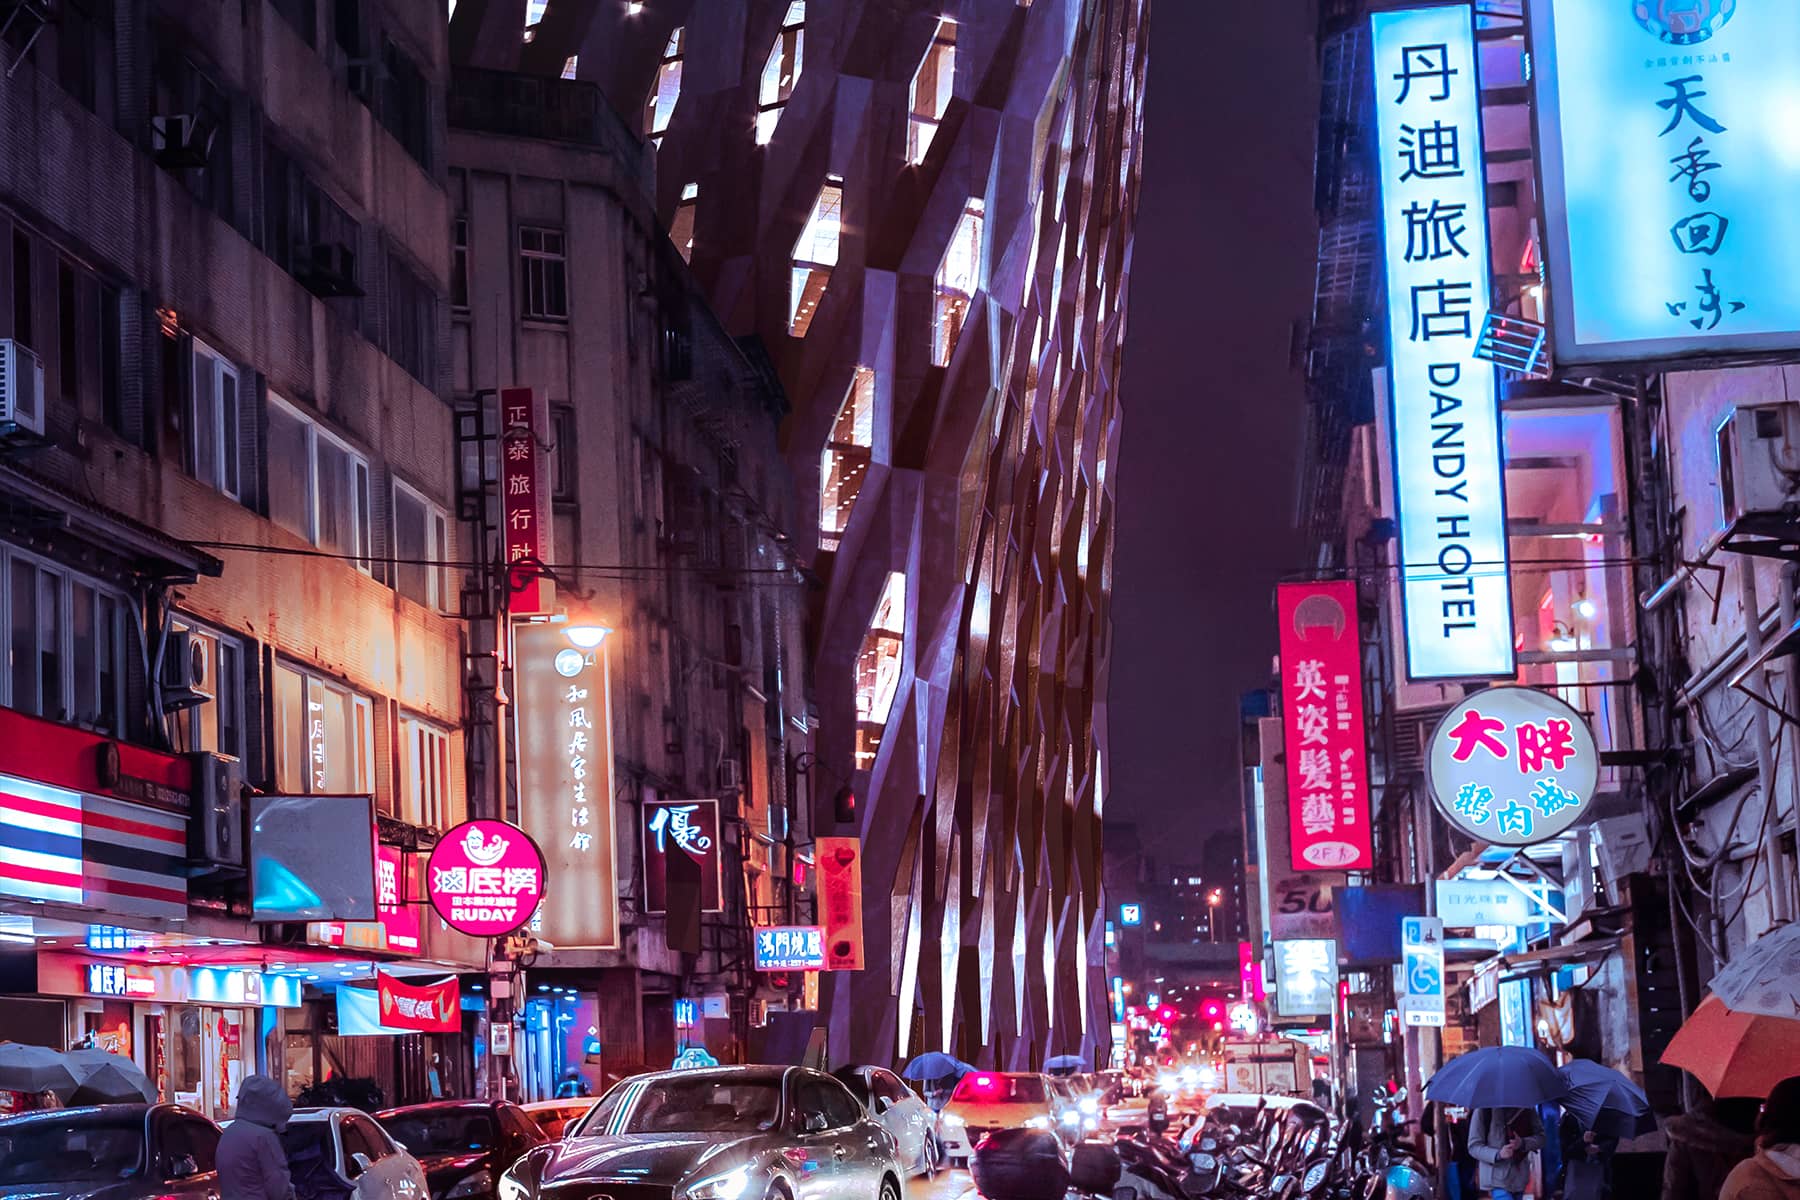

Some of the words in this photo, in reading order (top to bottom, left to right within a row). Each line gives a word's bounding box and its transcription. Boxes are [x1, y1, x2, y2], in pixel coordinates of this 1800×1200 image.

[1393, 43, 1473, 342] 丹迪旅店
[1655, 74, 1746, 330] 天香回味
[508, 405, 532, 563] 正泰旅行社
[1428, 362, 1468, 503] DANDY
[1436, 515, 1476, 638] HOTEL
[1293, 659, 1335, 835] 英姿髮藝
[1448, 709, 1577, 774] 大胖
[1453, 777, 1580, 837] 鵝肉城
[451, 908, 517, 922] RUDAY
